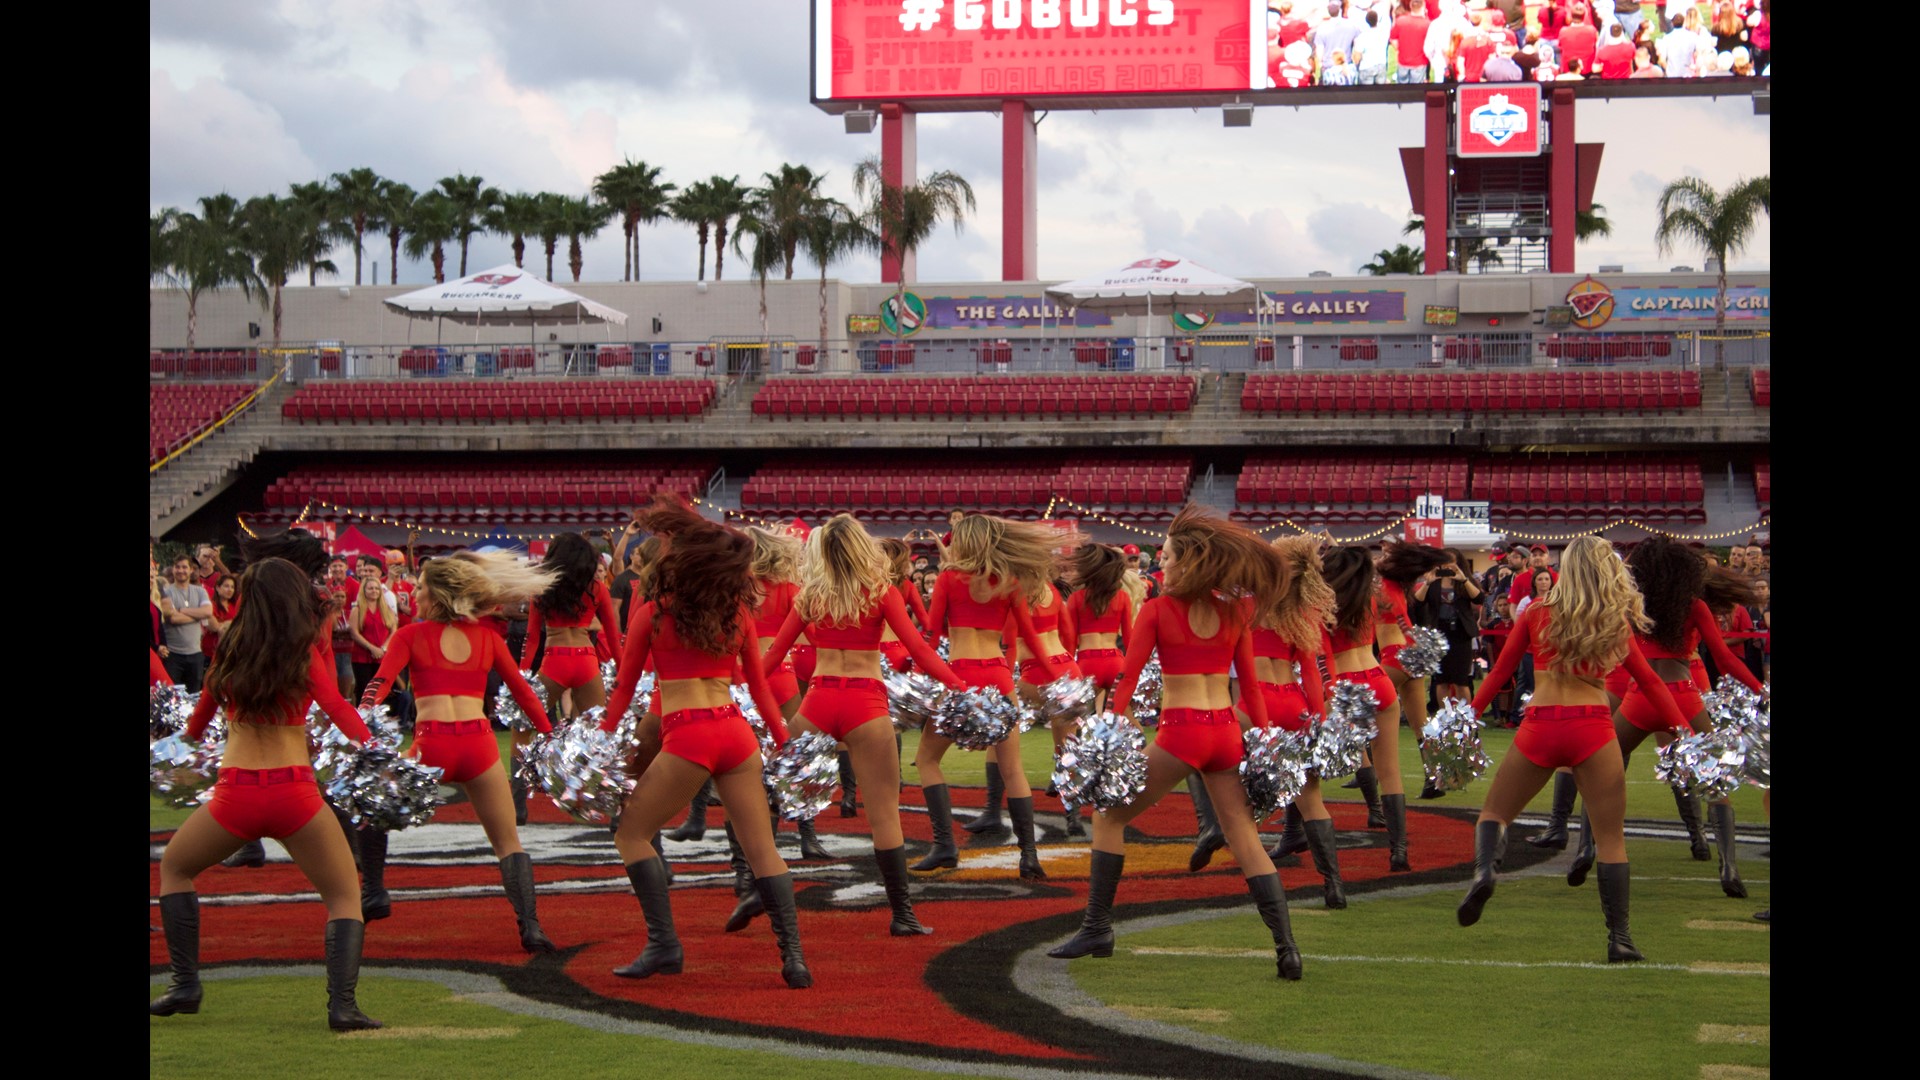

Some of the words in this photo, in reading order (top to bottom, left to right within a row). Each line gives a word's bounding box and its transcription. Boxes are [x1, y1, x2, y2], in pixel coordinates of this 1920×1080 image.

[898, 0, 1175, 32] #GOBUCS
[865, 40, 973, 65] FUTURE
[865, 68, 891, 92] IS
[898, 67, 962, 92] NOW
[980, 64, 1105, 93] DALLAS
[1116, 62, 1203, 91] 2018
[1104, 276, 1190, 286] BUCCANEERS
[441, 291, 523, 300] BUCCANEERS
[1631, 296, 1730, 310] CAPTAINS
[956, 305, 996, 319] THE
[1291, 300, 1370, 315] GALLEY
[1445, 506, 1471, 519] BAR
[1473, 506, 1489, 519] 75
[1414, 523, 1439, 541] Lite
